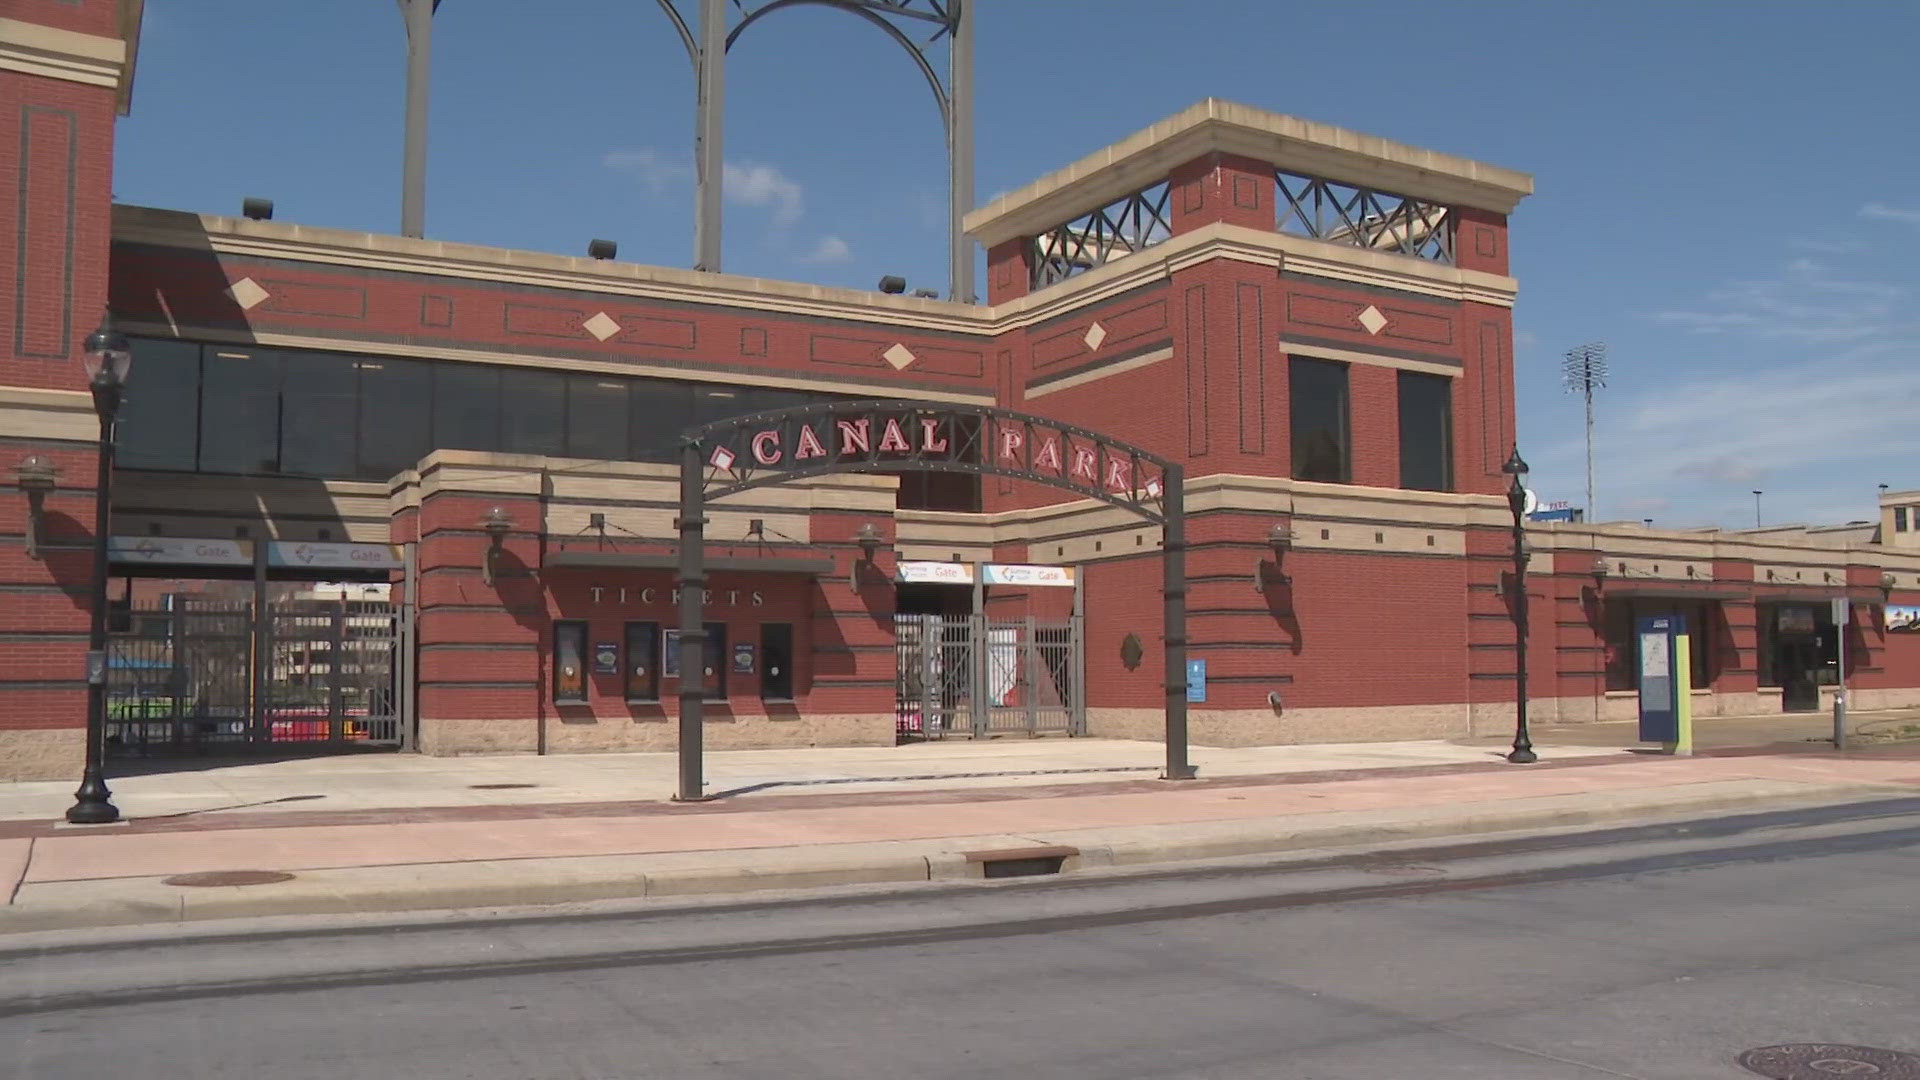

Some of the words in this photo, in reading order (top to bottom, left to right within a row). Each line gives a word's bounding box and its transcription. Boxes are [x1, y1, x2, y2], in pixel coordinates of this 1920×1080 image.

[752, 419, 947, 464] CANAL
[1000, 428, 1132, 490] PARK
[195, 544, 230, 557] Gate
[351, 550, 382, 561] Gate
[935, 567, 957, 577] Gate
[1039, 571, 1059, 580] Gate
